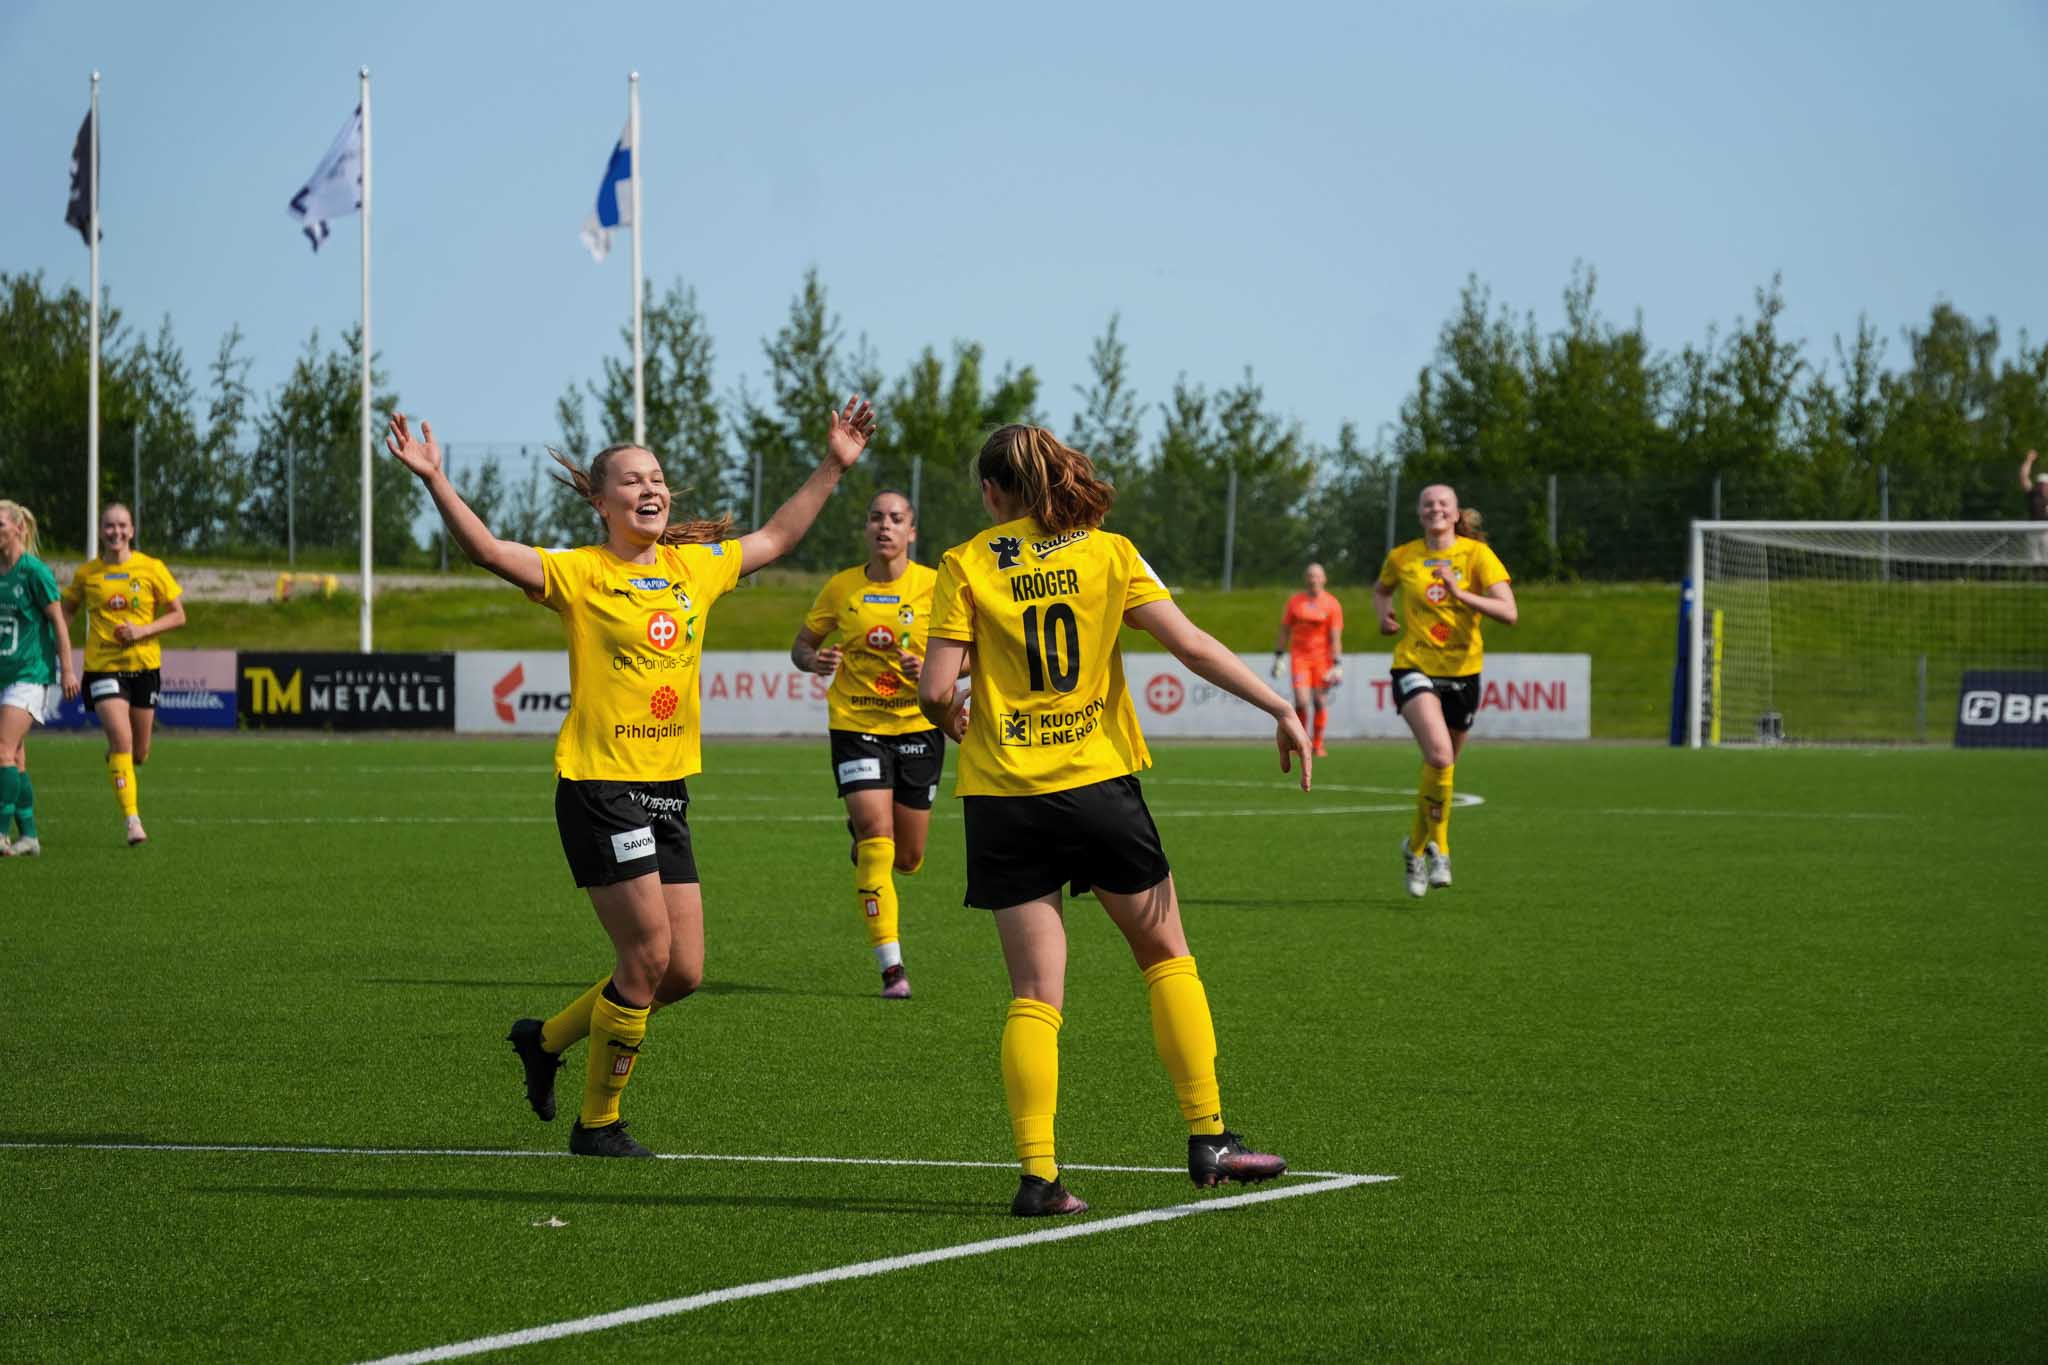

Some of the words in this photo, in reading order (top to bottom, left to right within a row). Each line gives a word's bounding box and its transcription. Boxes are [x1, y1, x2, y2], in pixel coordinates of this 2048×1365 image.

[1010, 568, 1080, 602] KRÖGER
[613, 656, 632, 671] OP
[1022, 603, 1080, 692] 10
[244, 667, 303, 715] TM
[310, 685, 446, 713] METALLI
[1369, 679, 1567, 712] TANNI
